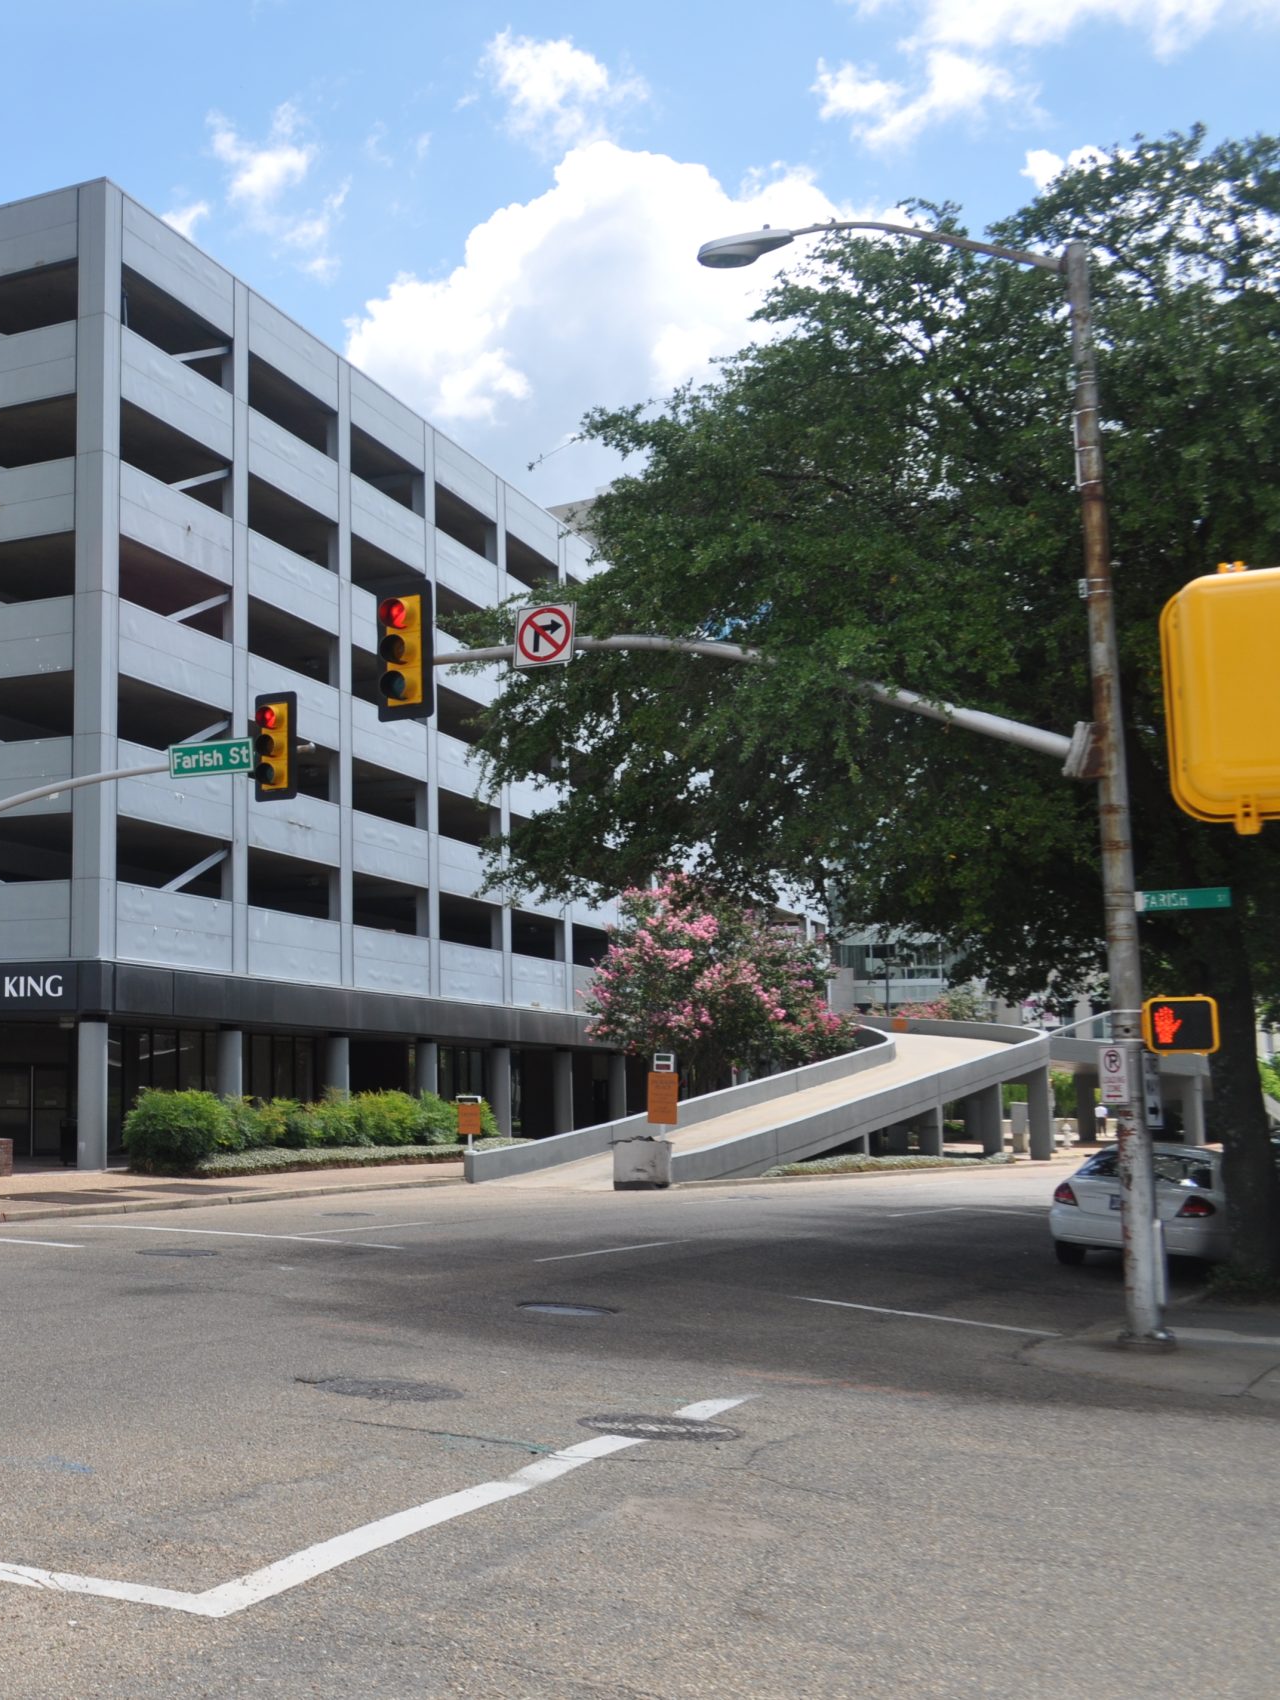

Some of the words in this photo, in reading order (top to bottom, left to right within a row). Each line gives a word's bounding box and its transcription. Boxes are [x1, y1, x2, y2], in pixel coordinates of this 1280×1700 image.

[173, 750, 223, 769] Farish
[229, 746, 249, 764] St
[1143, 892, 1188, 908] FARISH
[4, 974, 63, 998] KING
